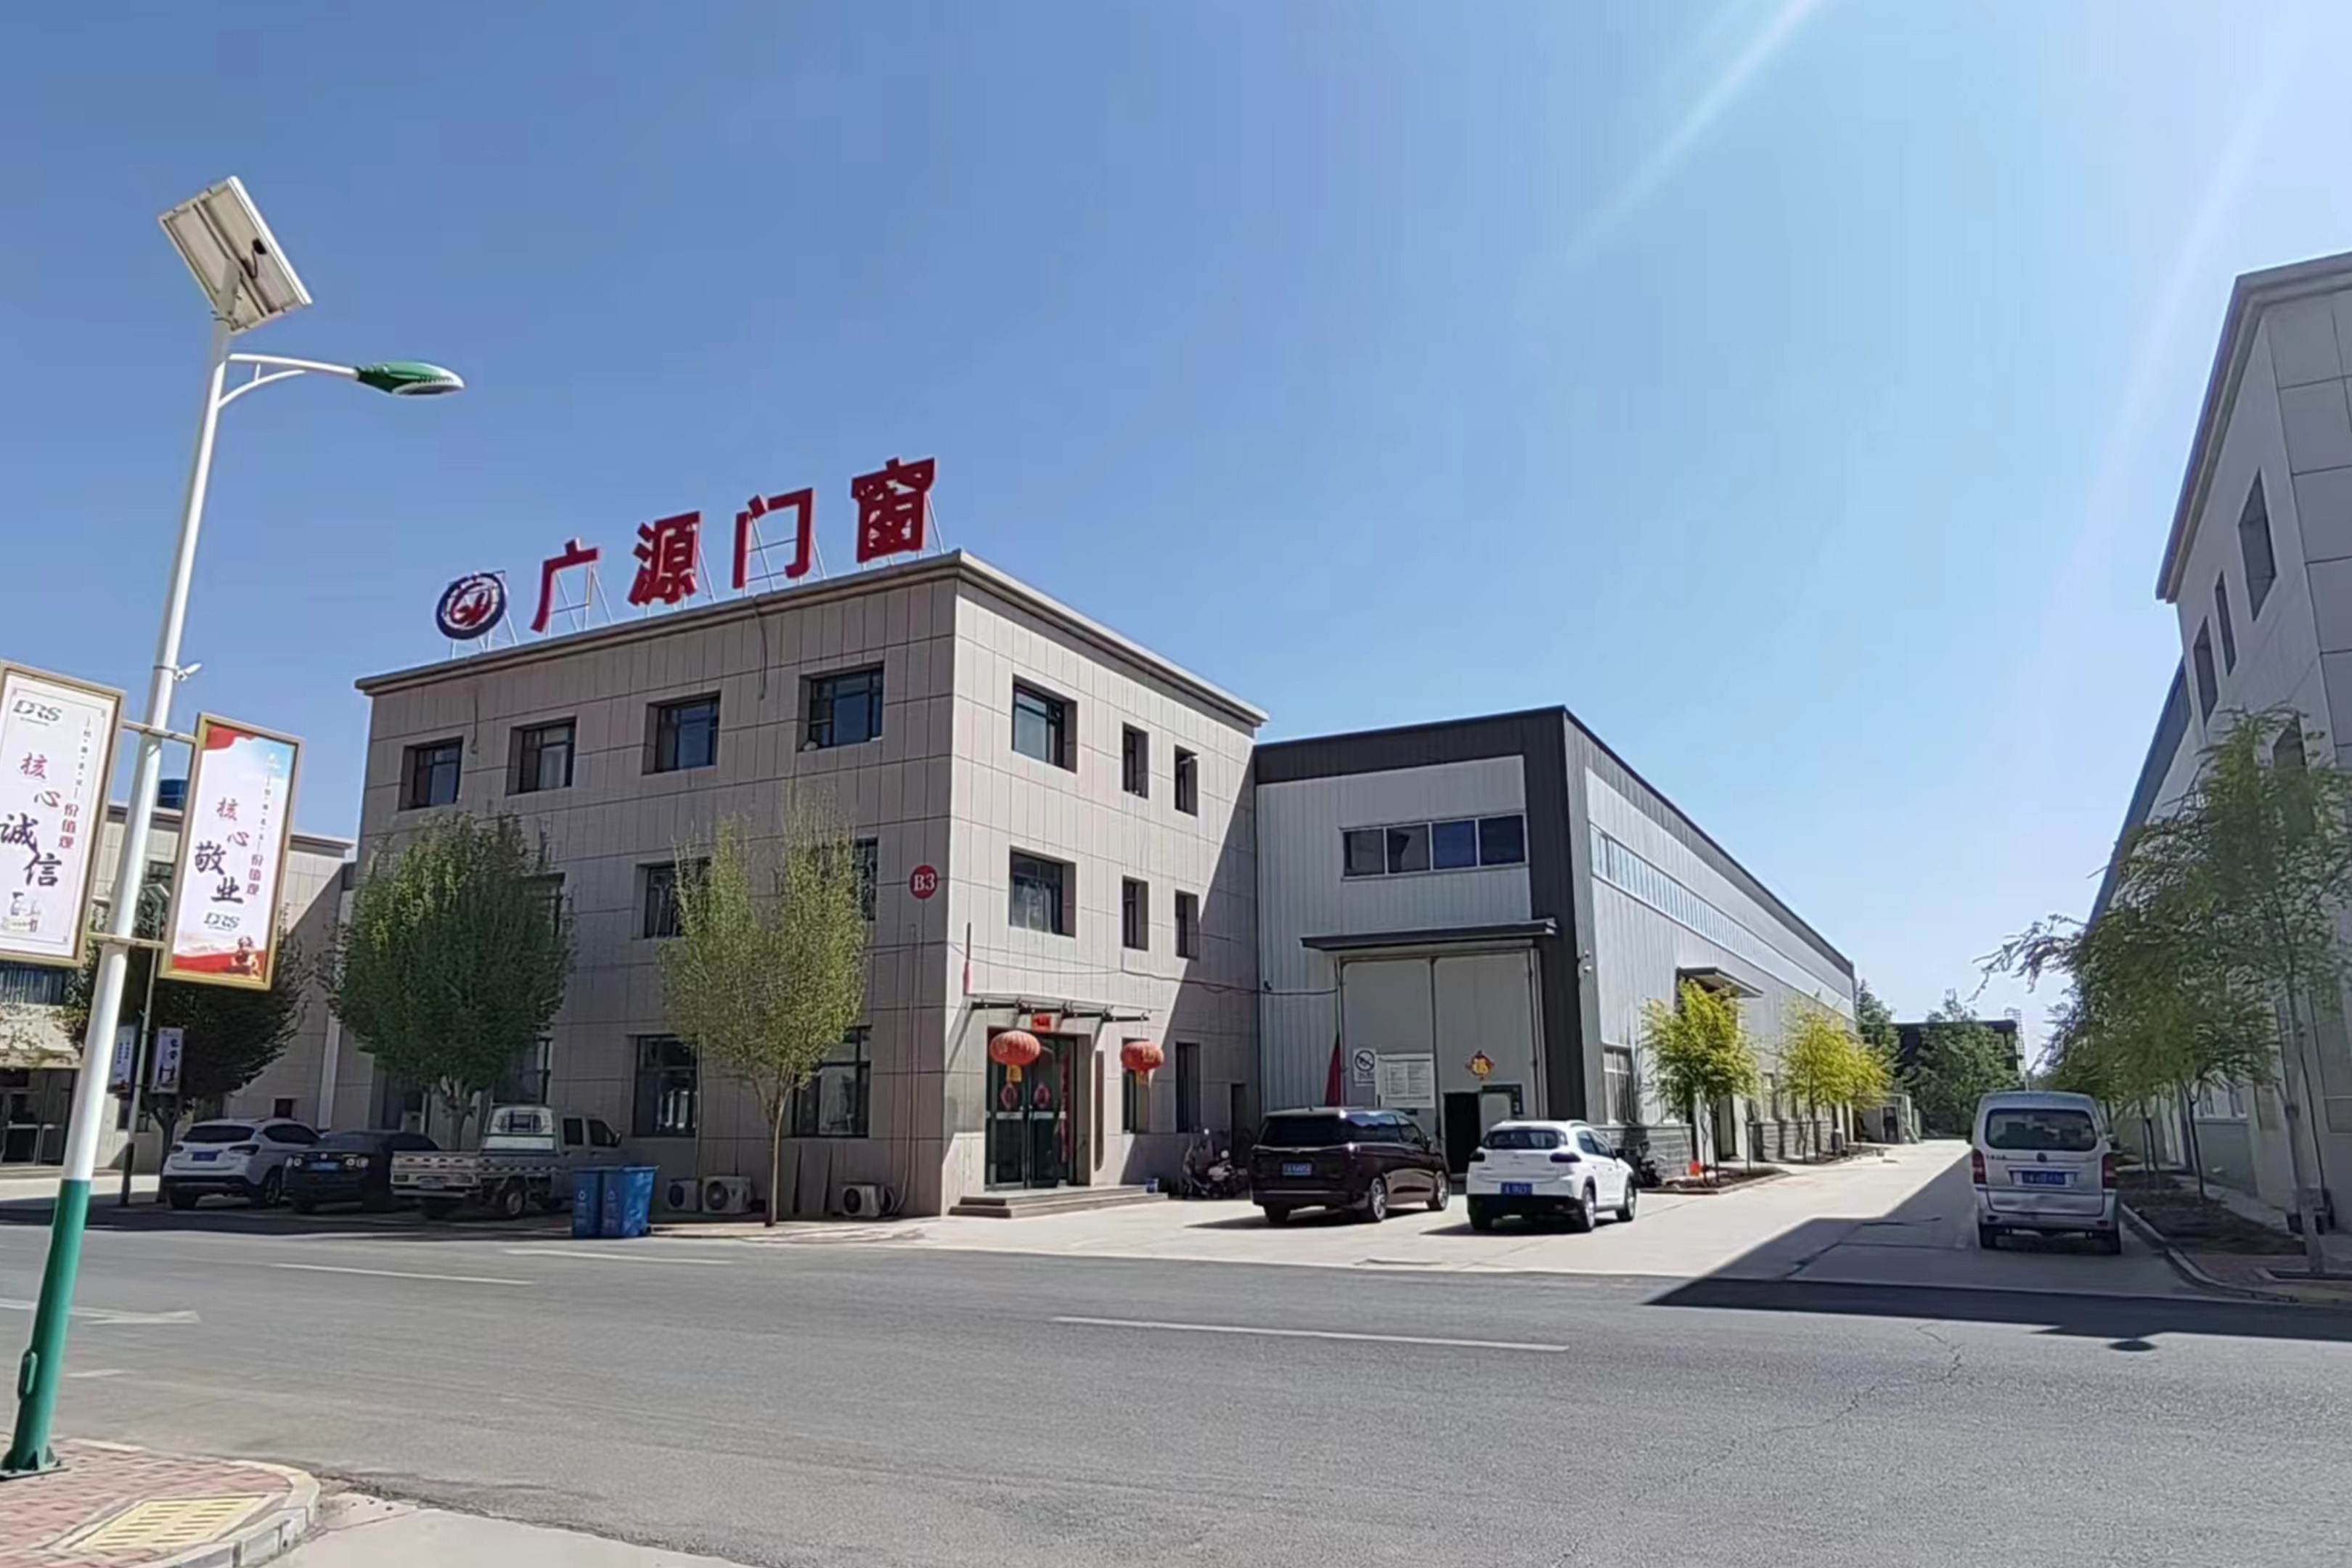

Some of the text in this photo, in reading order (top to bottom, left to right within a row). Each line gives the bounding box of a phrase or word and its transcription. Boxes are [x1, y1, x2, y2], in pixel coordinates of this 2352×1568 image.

[531, 457, 935, 632] 广源门窗
[0, 812, 62, 886] 诚信
[195, 841, 244, 904] 敬业
[914, 873, 935, 891] B3
